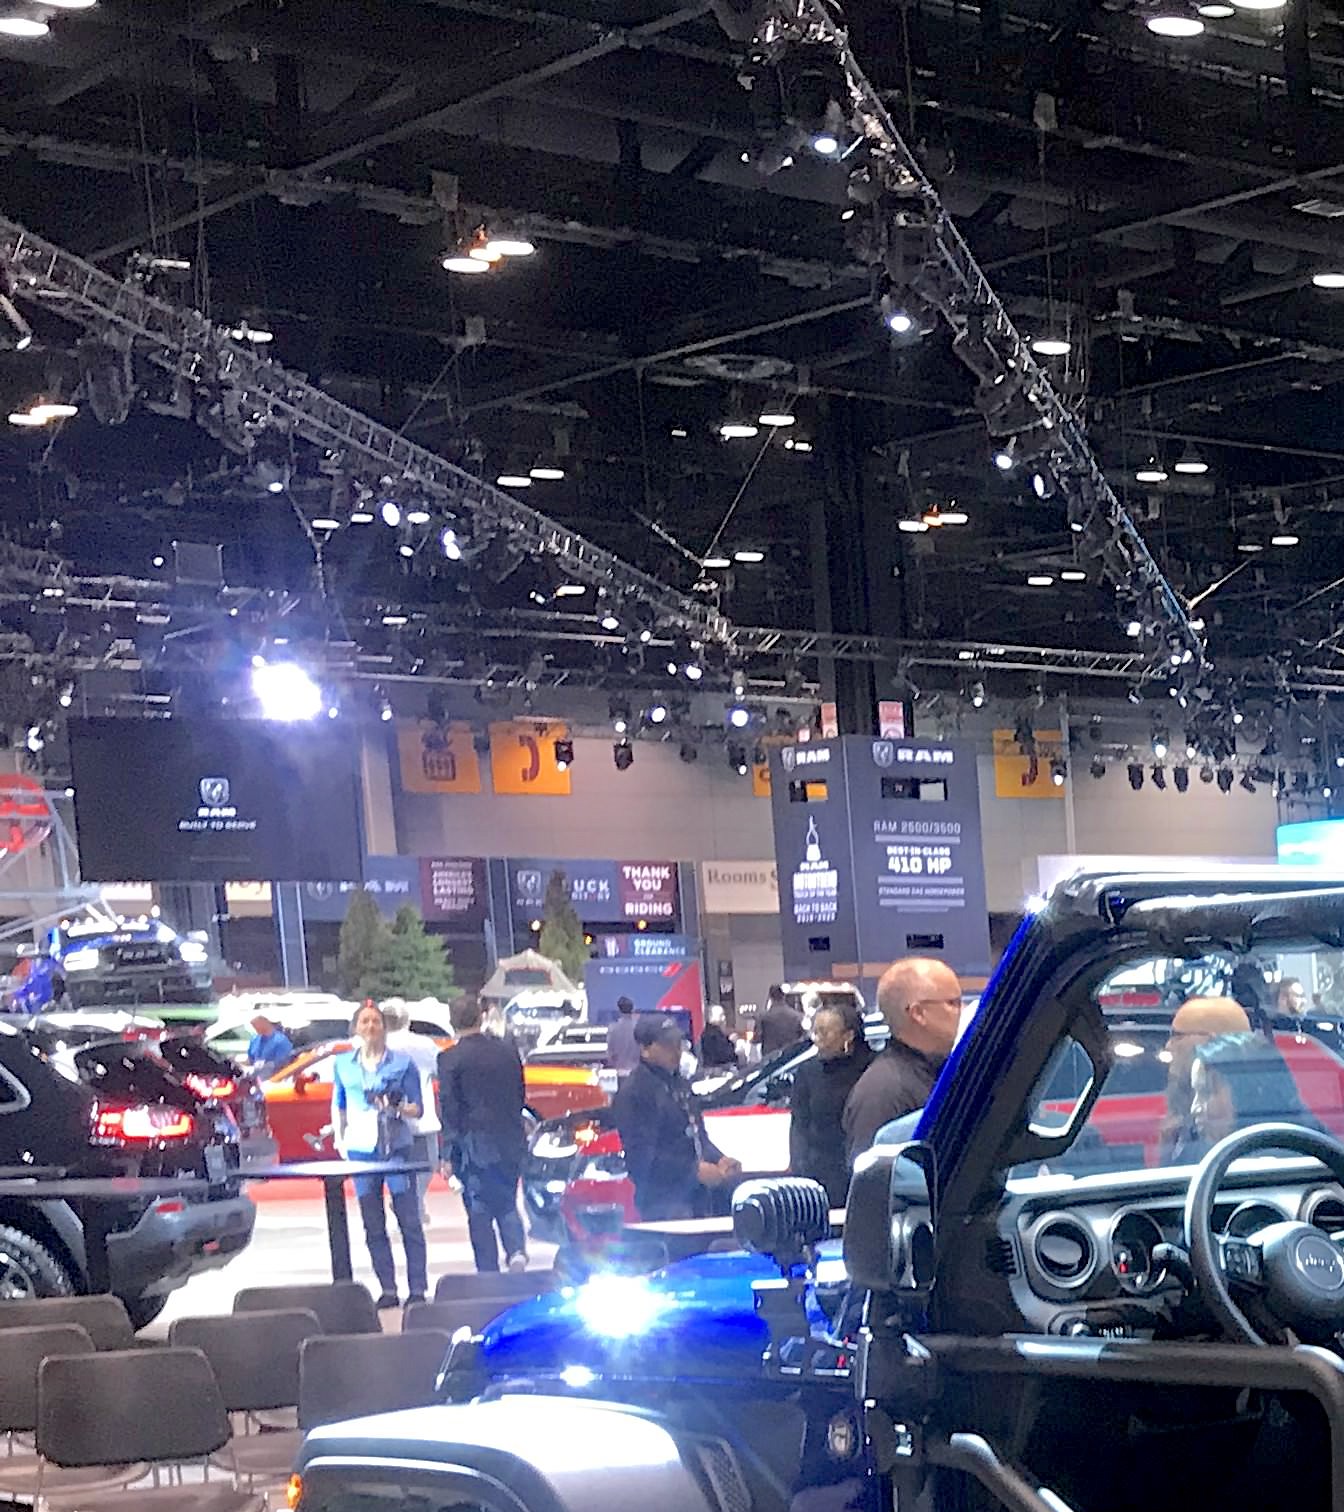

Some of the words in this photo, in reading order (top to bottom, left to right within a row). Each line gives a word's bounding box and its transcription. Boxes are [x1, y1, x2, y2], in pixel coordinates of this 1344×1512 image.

[797, 749, 830, 765] RAM
[897, 749, 953, 764] RAM
[873, 820, 897, 832] RAM
[888, 857, 922, 873] 410
[927, 857, 952, 874] HP
[622, 866, 670, 880] THANK
[708, 868, 767, 885] Rooms
[633, 879, 661, 891] YOU
[625, 903, 673, 916] RIDING
